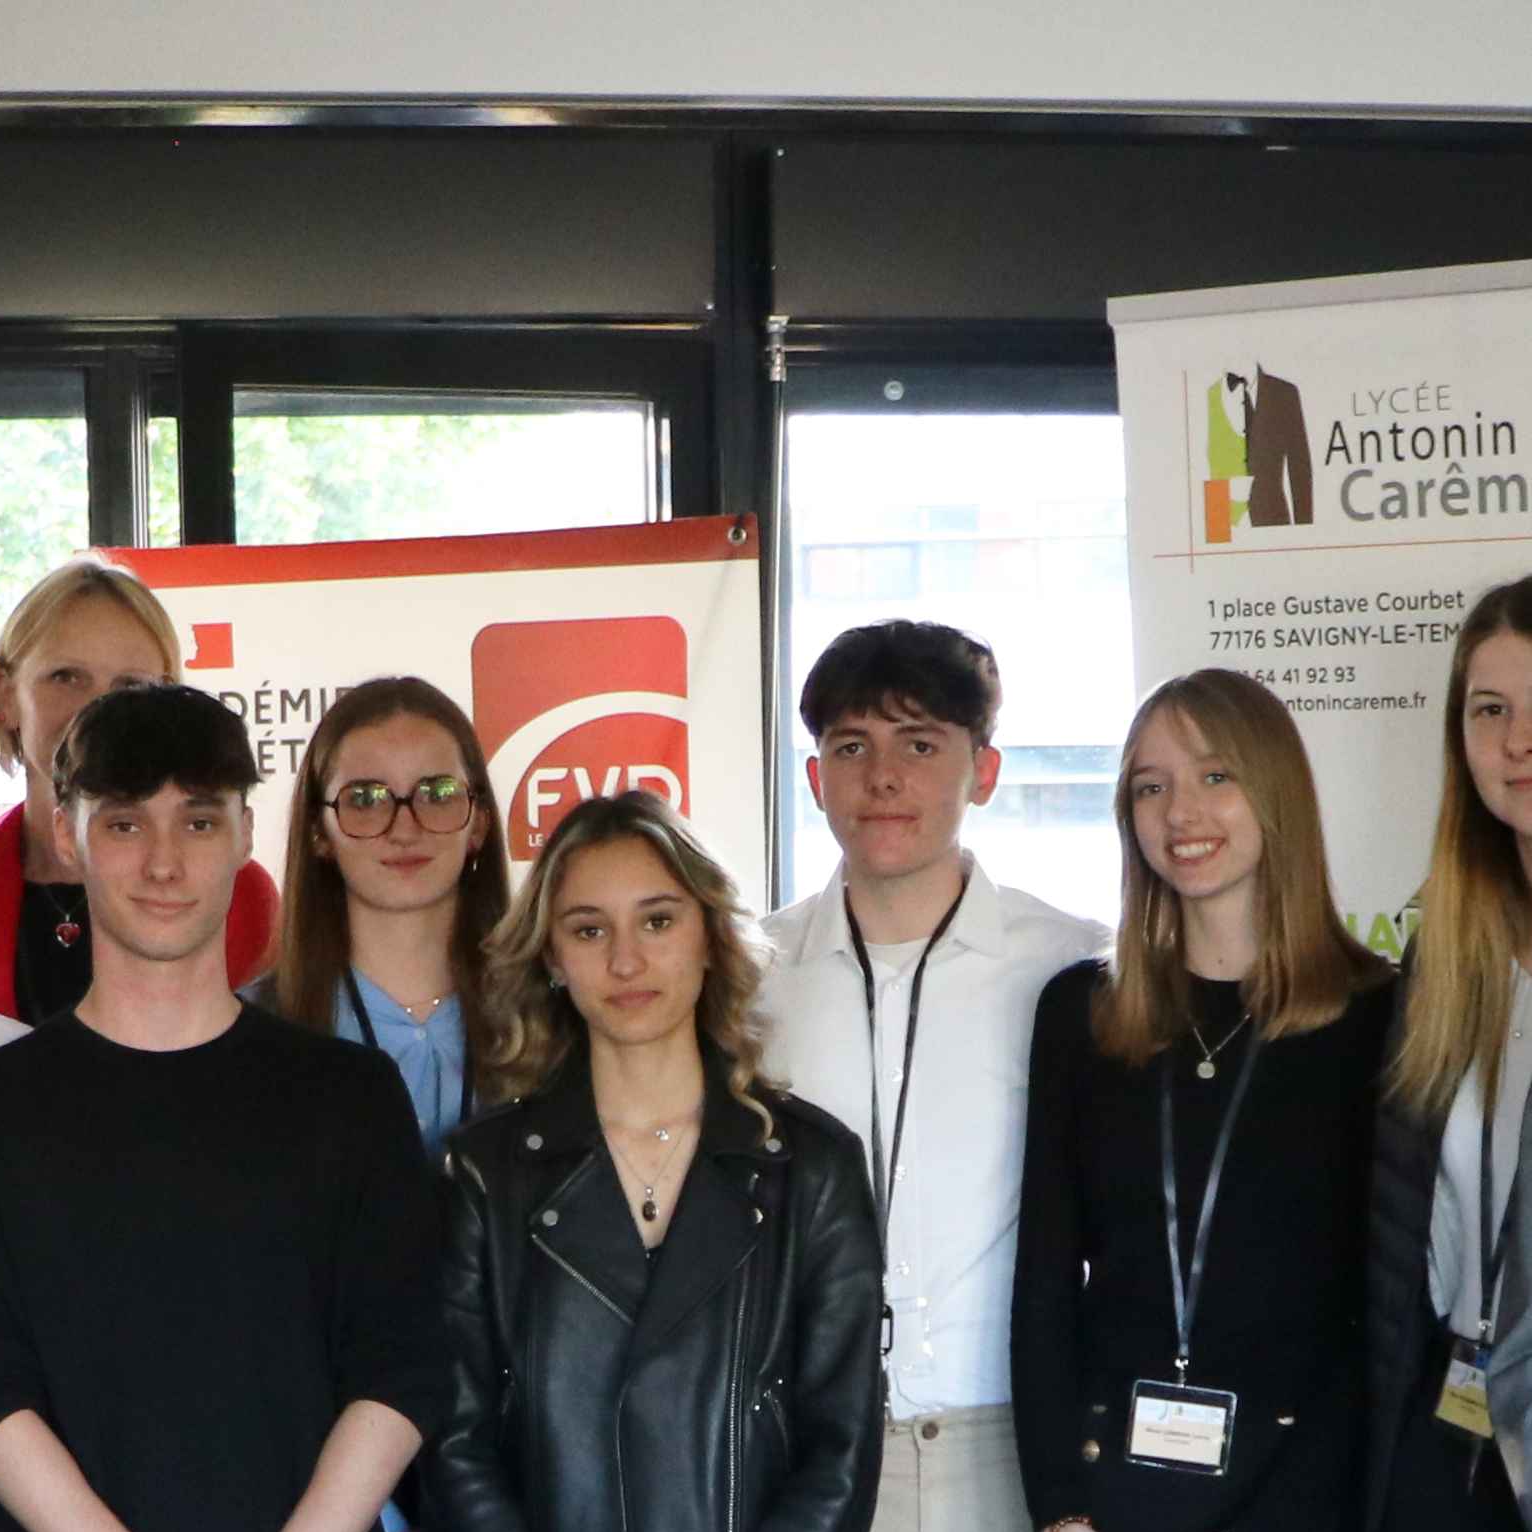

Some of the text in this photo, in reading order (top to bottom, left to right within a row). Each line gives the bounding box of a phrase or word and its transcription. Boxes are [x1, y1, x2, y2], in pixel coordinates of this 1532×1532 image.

[1352, 381, 1452, 416] LYCÉE
[1325, 411, 1516, 466] Antonin
[1208, 590, 1466, 621] 1 place Gustave Courbet
[1210, 630, 1266, 650] 77176
[1282, 668, 1300, 684] 41
[1306, 667, 1329, 684] 92
[1334, 666, 1357, 683] 93
